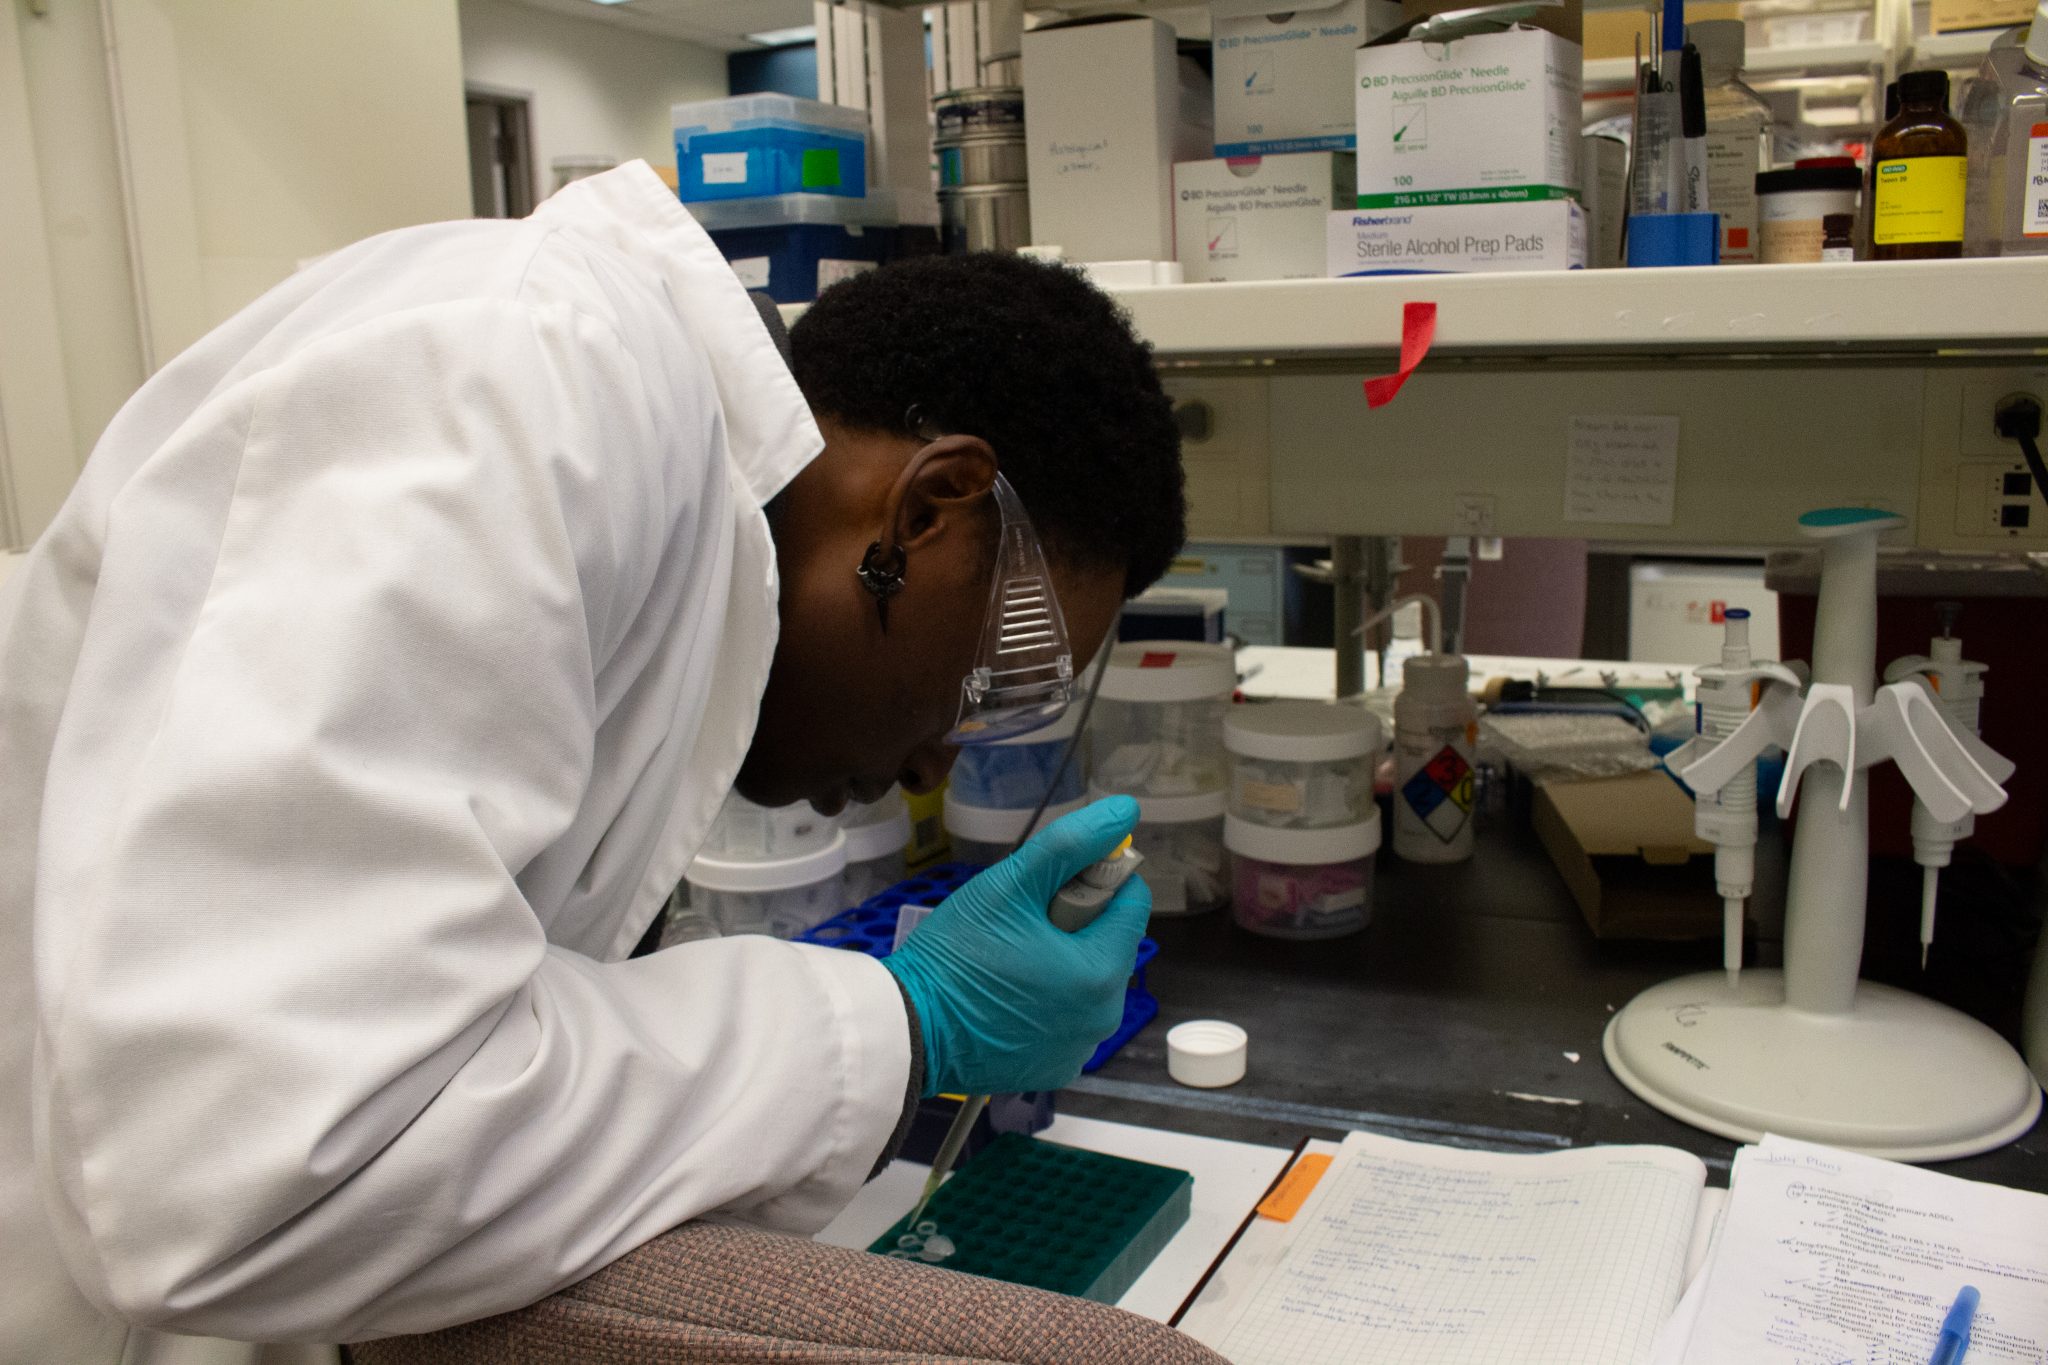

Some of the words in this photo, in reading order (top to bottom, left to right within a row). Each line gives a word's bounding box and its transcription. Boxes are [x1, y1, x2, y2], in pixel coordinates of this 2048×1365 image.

[1373, 76, 1389, 88] BD
[1471, 64, 1510, 78] Needle
[1392, 87, 1429, 102] Aiguille
[1431, 86, 1447, 97] BD
[1273, 184, 1308, 195] Needle
[1393, 175, 1413, 186] 100
[1357, 239, 1402, 258] Sterile
[1406, 236, 1460, 256] Alcohol
[1464, 236, 1499, 255] Prep
[1505, 234, 1544, 252] Pads
[1440, 756, 1458, 785] 3
[1461, 777, 1473, 804] 0
